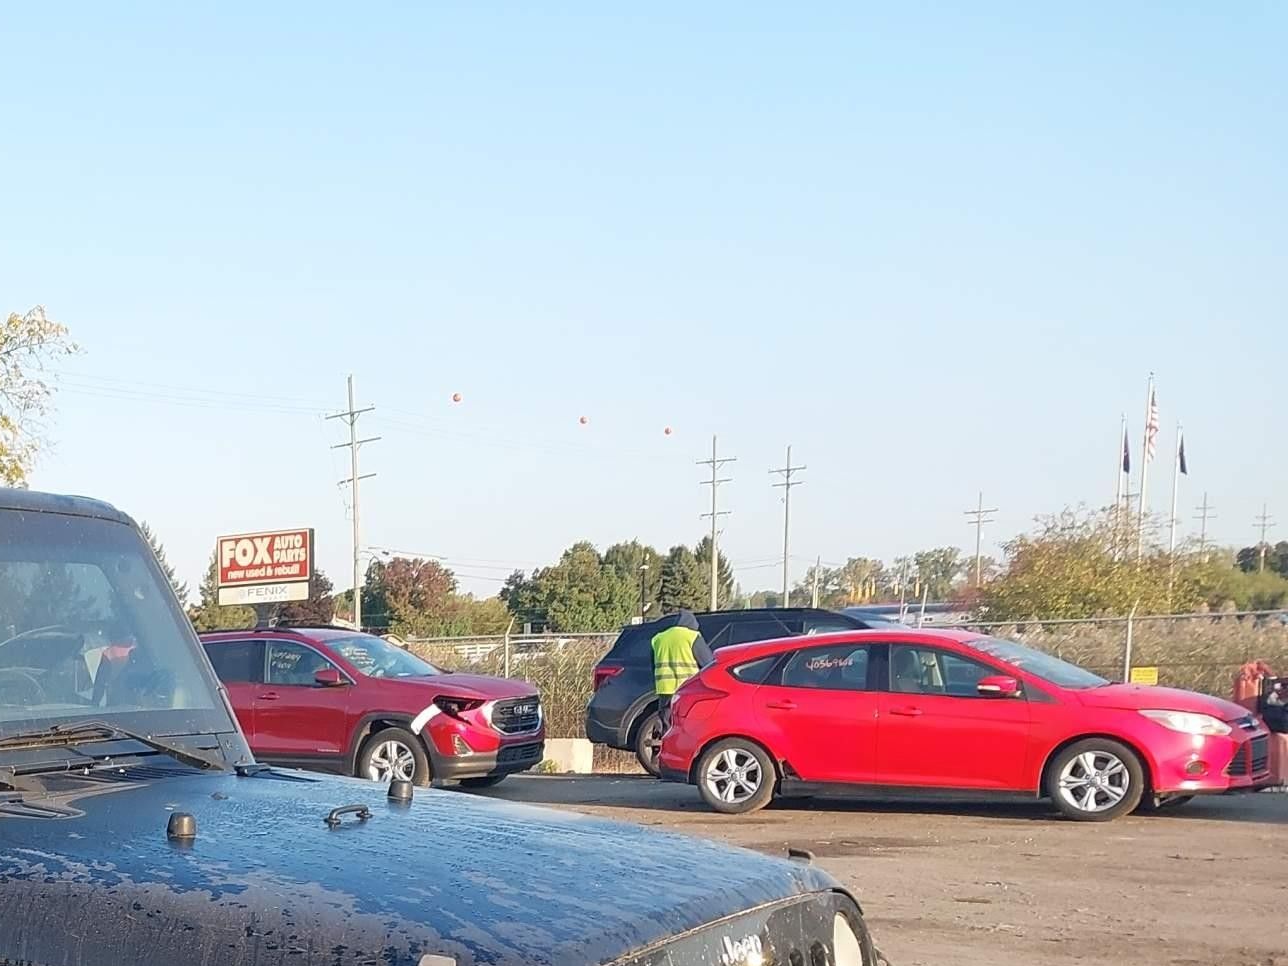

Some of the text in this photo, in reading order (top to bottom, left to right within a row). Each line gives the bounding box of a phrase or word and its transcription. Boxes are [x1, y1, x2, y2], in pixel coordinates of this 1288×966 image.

[274, 535, 303, 549] AUTO
[221, 537, 272, 568] FOX
[273, 548, 306, 563] PARTS
[227, 570, 245, 579] new
[245, 566, 266, 577] used
[247, 586, 288, 597] FENIX
